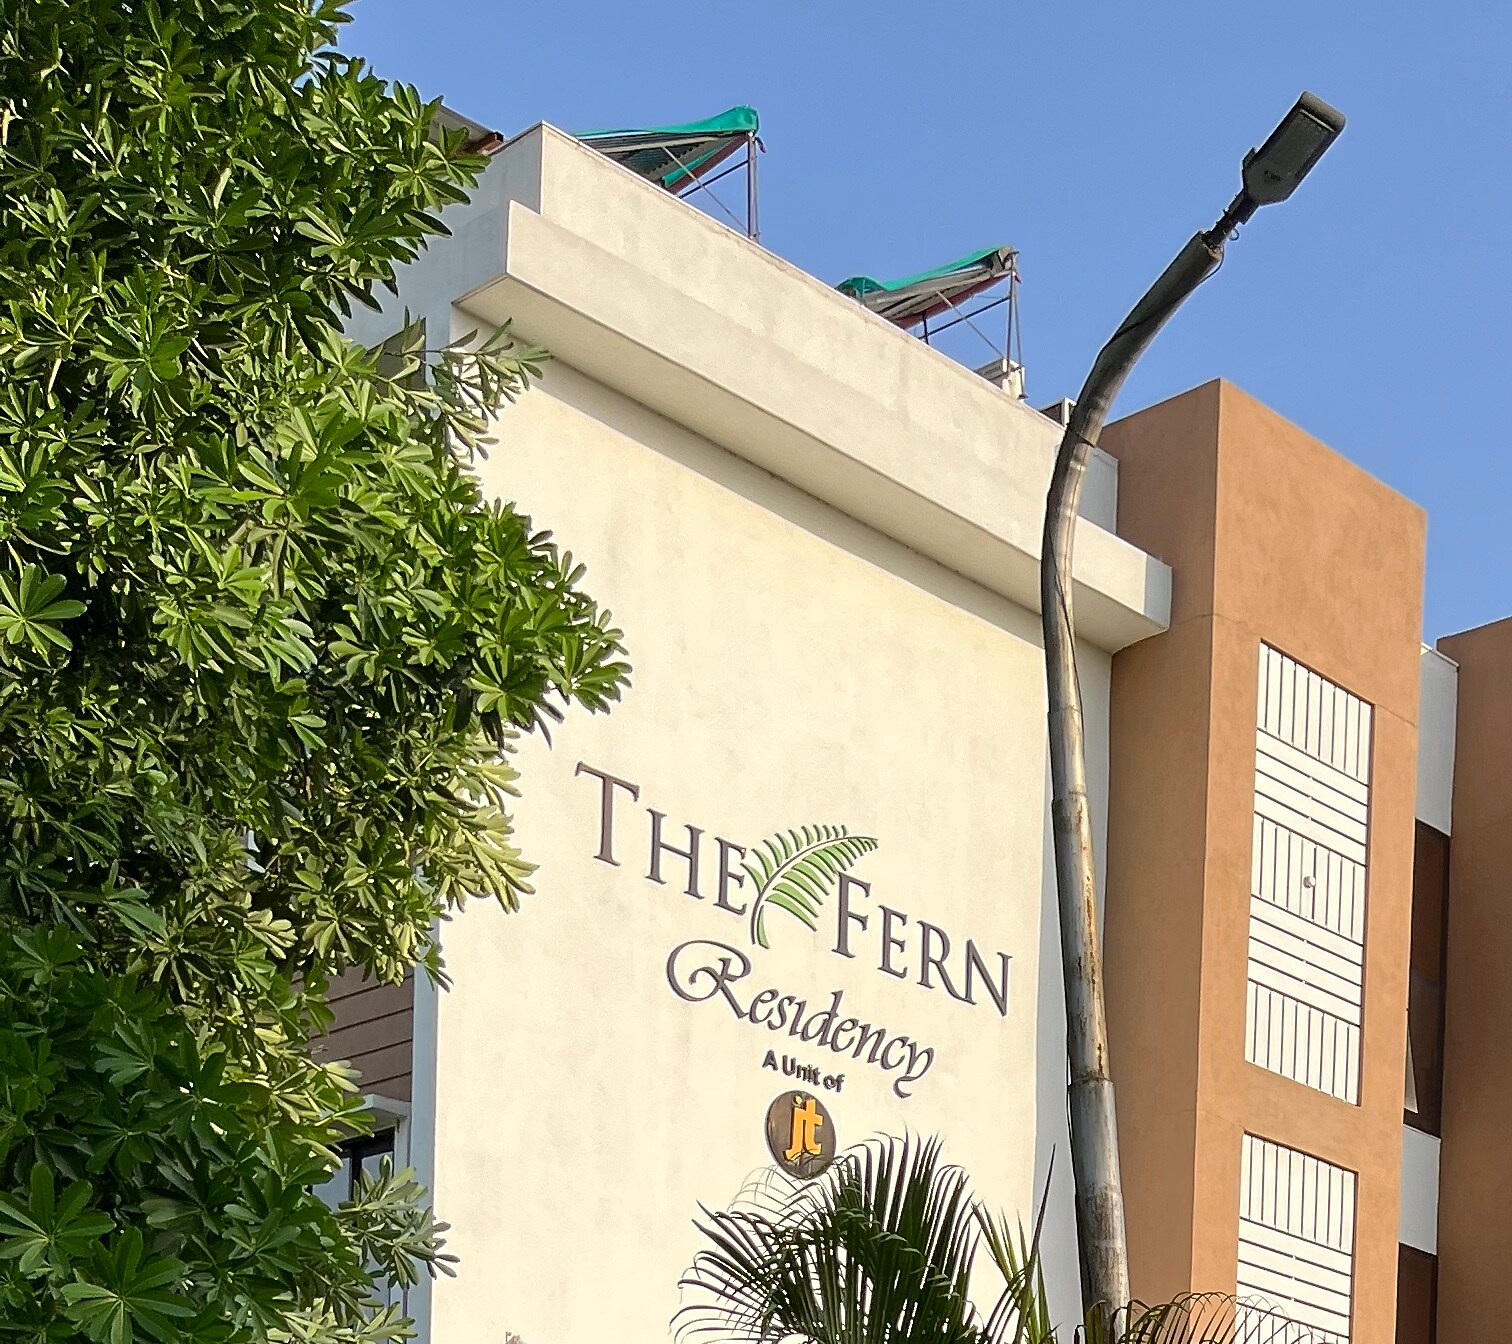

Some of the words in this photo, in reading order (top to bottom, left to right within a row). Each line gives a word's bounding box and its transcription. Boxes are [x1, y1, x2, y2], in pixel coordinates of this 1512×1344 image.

[574, 760, 747, 916] THE
[831, 870, 1014, 1018] FERN
[666, 939, 935, 1099] Residency
[762, 1049, 779, 1072] A
[781, 1054, 821, 1087] Unit
[823, 1073, 846, 1093] of
